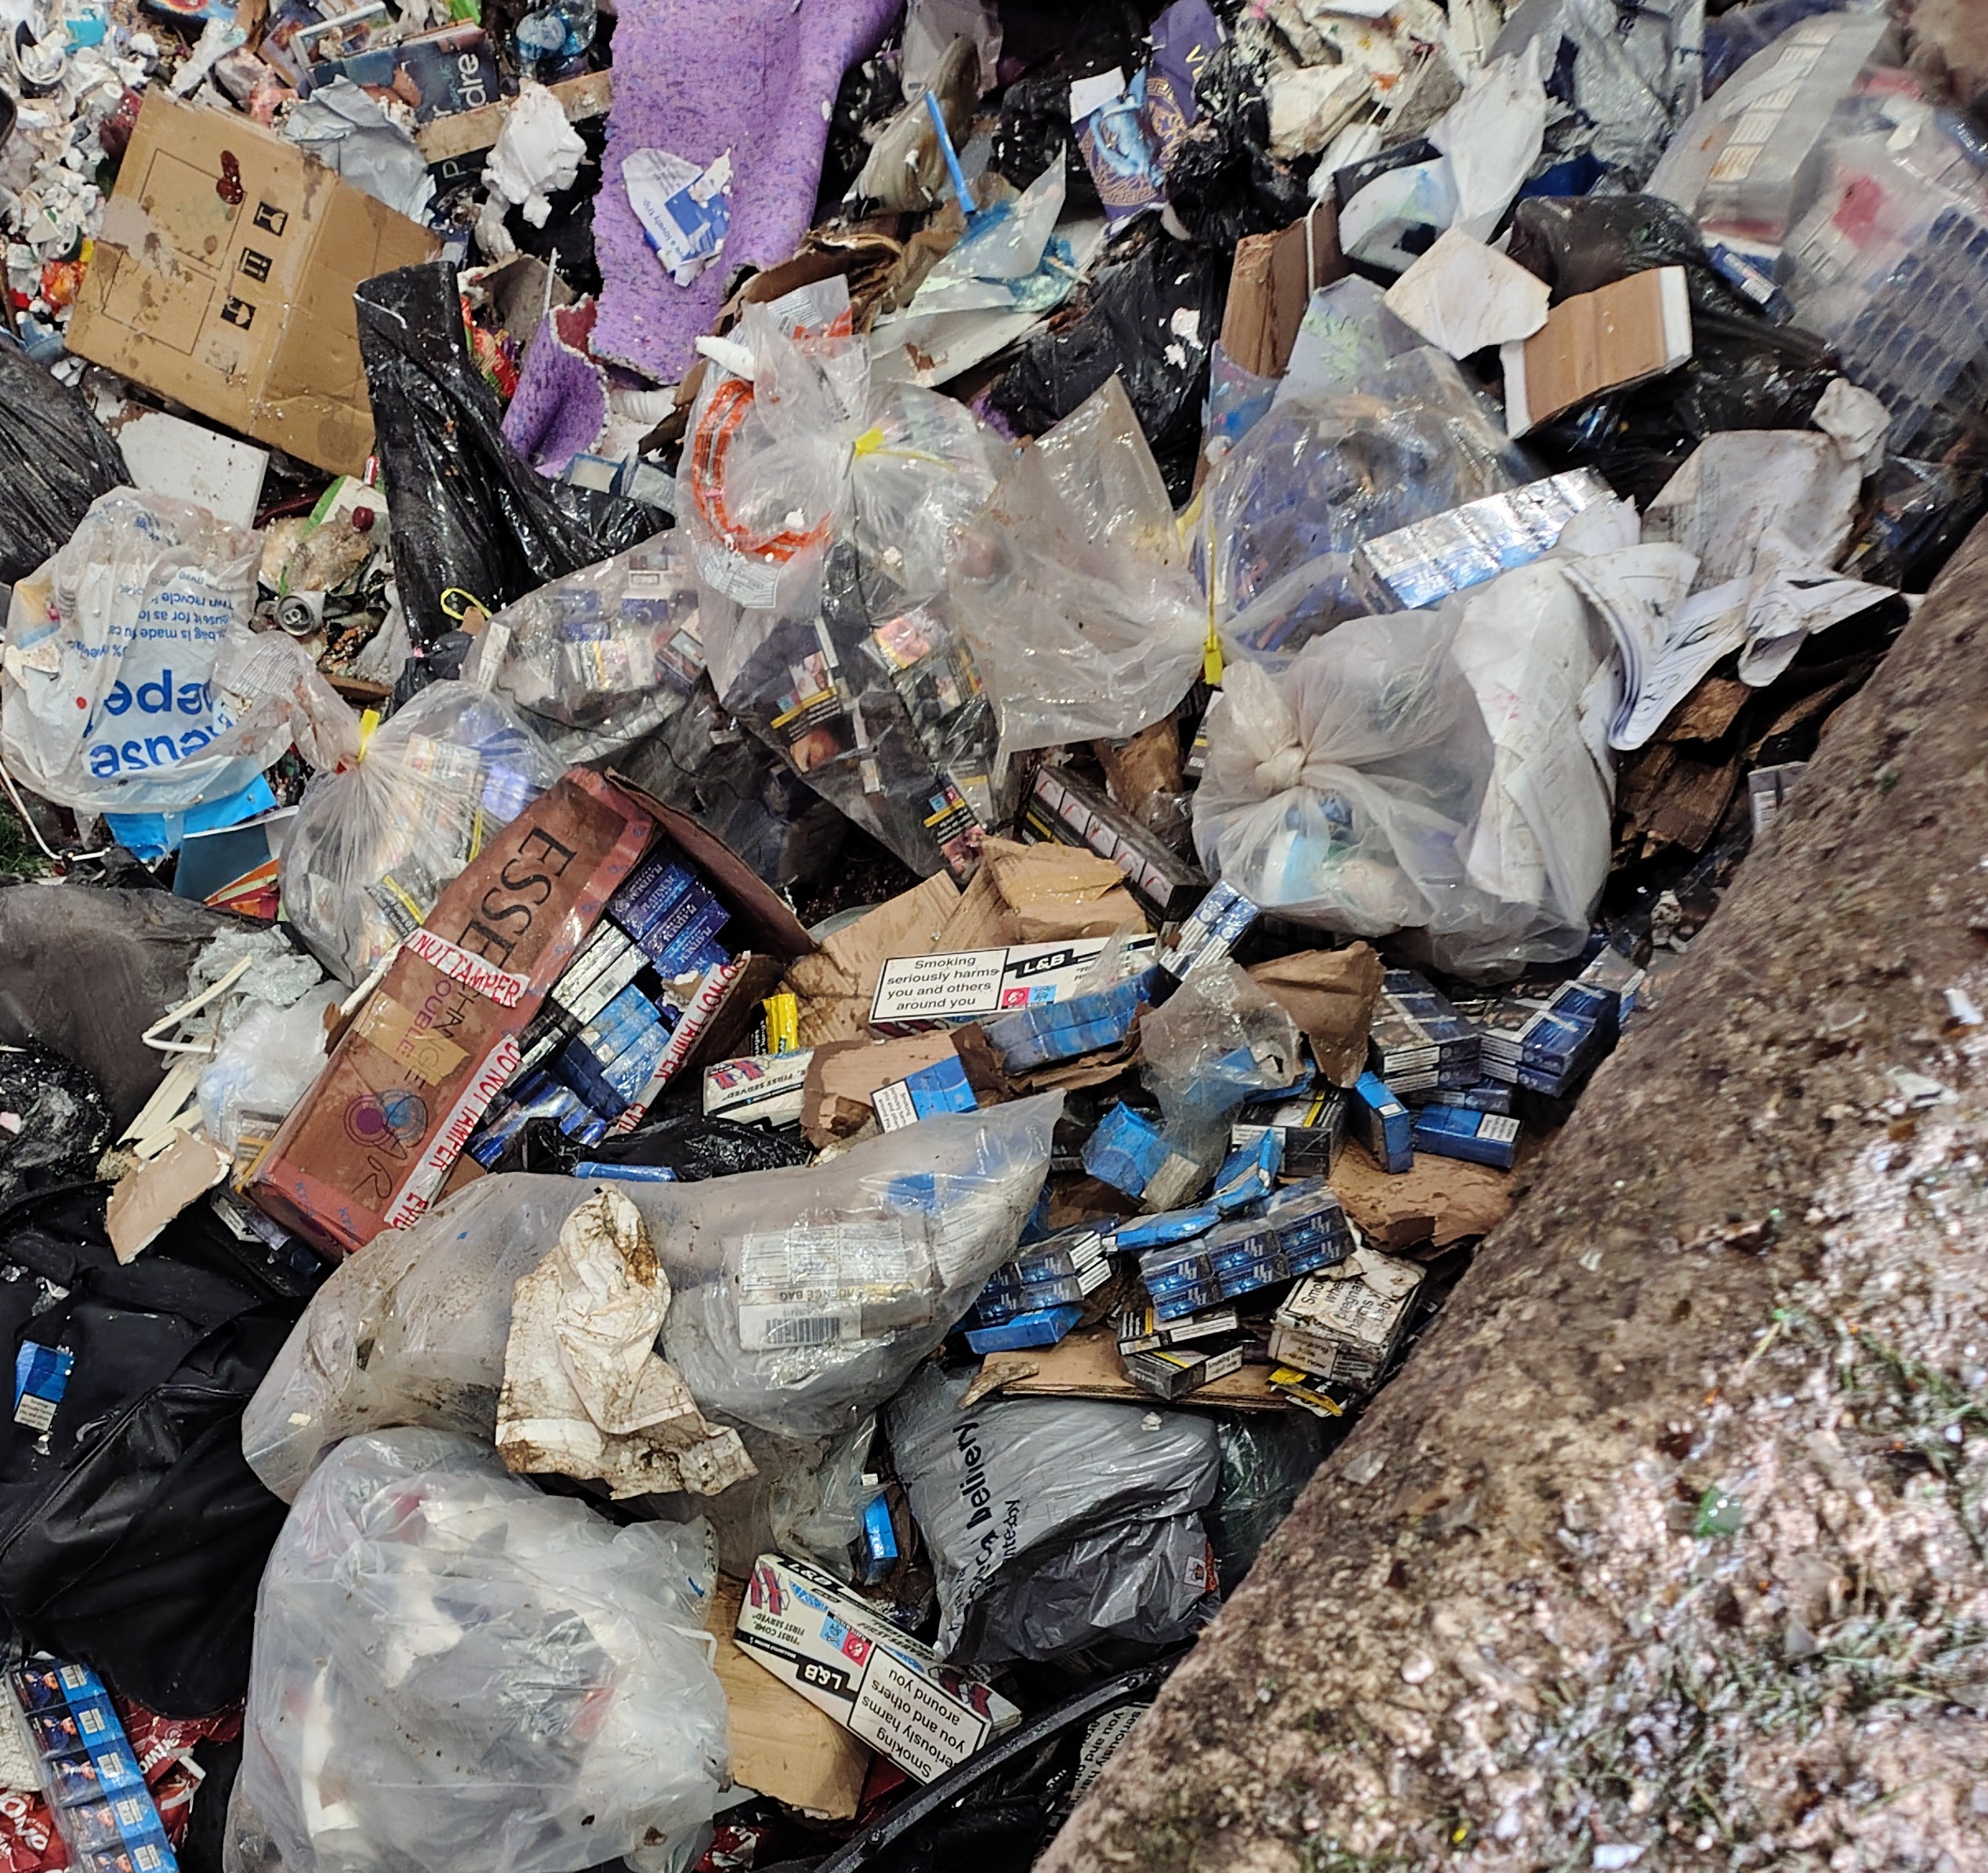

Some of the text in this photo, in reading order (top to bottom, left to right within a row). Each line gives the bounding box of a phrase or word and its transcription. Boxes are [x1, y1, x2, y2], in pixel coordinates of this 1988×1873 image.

[651, 214, 673, 241] lovely
[140, 627, 176, 641] made
[172, 612, 189, 623] for
[448, 952, 524, 1010] TAMPER
[885, 967, 997, 986] seriously harms
[912, 956, 977, 971] Smoking
[1021, 953, 1066, 974] L&B
[885, 982, 992, 1000] you and others
[894, 997, 975, 1011] around you
[400, 985, 449, 1057] OUBLE
[653, 1014, 707, 1081] TAMPER
[428, 1104, 482, 1174] TAMPER
[779, 1290, 803, 1300] BAG
[1335, 1275, 1366, 1323] pregnan
[783, 1621, 805, 1637] FIRST
[802, 1661, 843, 1690] L&B
[886, 1667, 963, 1726] around you
[856, 1695, 960, 1771] eriously harms
[867, 1679, 967, 1753] you and others
[875, 1728, 933, 1778] Smoking
[1083, 1708, 1124, 1764] you and
[1094, 1704, 1141, 1773] seriously
